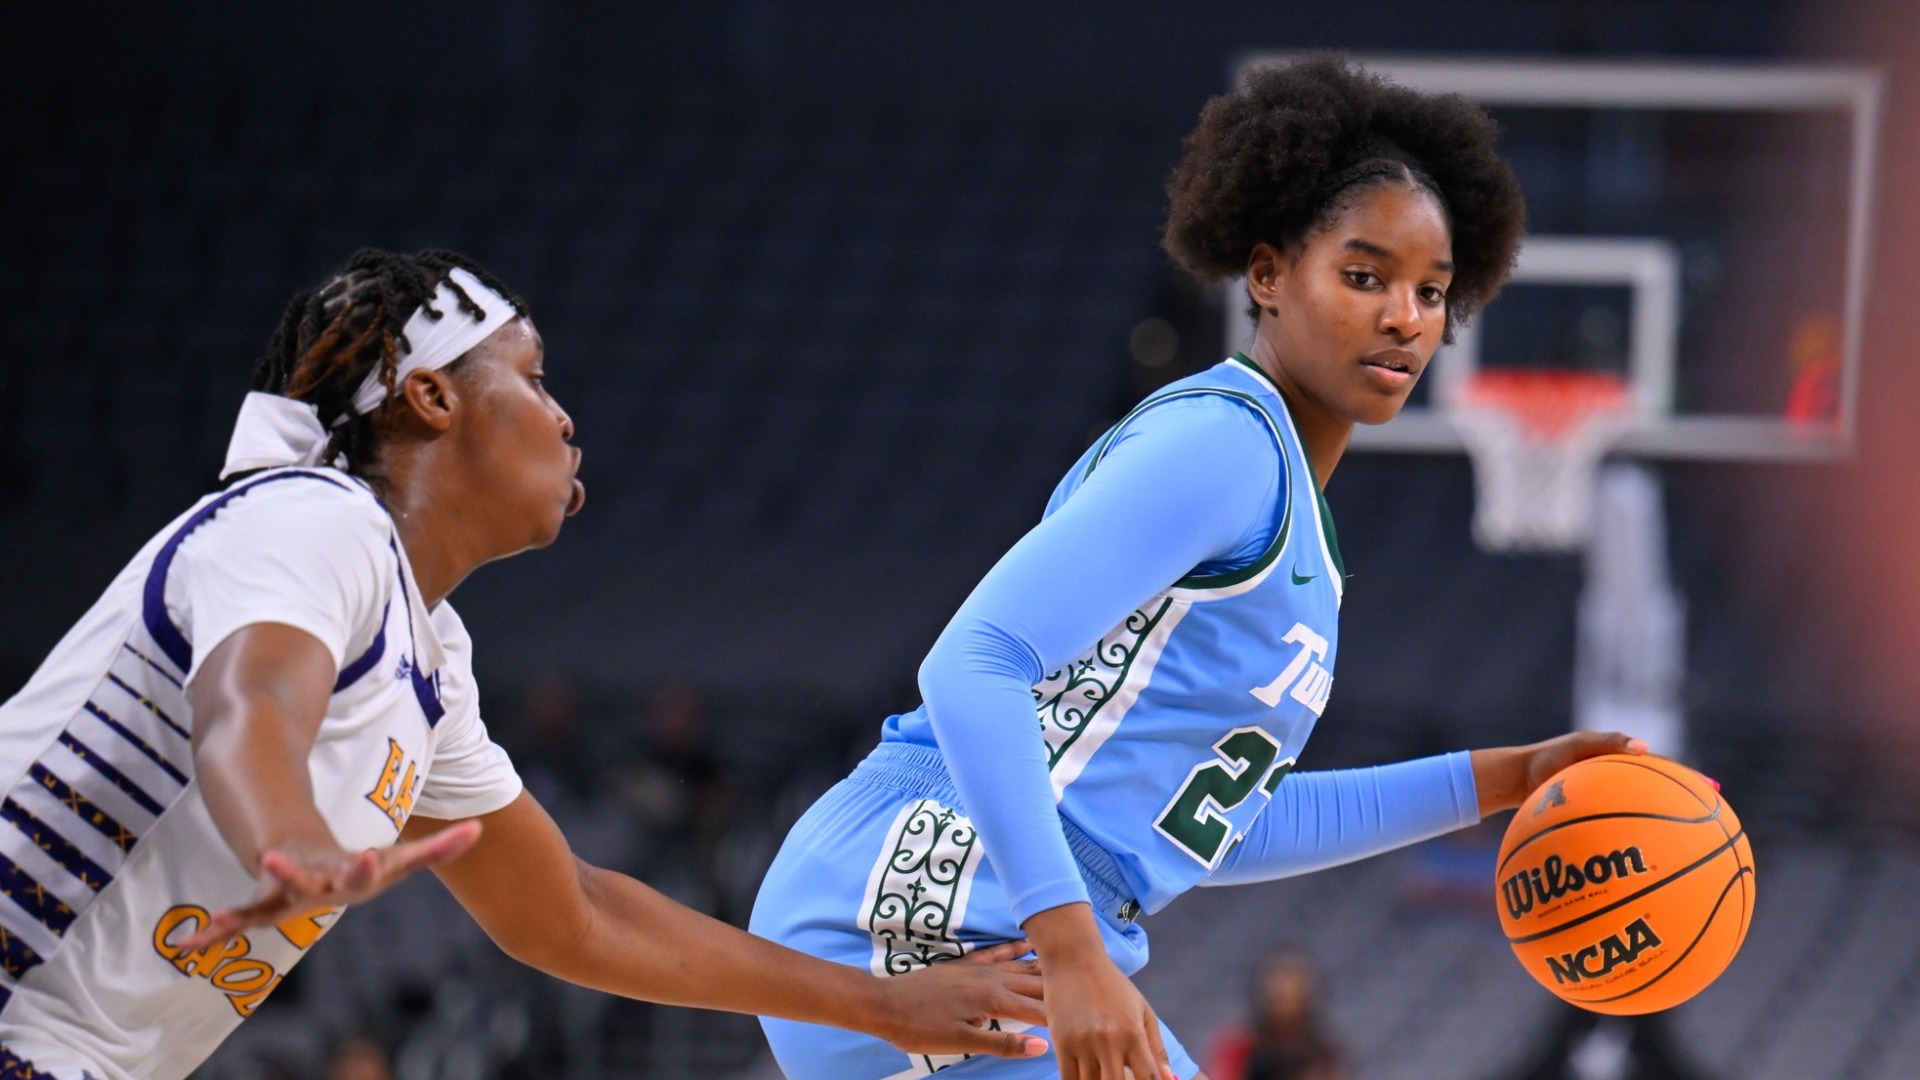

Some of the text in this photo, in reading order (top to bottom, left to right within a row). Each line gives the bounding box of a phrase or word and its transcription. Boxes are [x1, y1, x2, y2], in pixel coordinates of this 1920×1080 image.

[1152, 725, 1296, 876] 2
[1502, 845, 1647, 920] Wilson
[1545, 917, 1662, 985] NCAA
